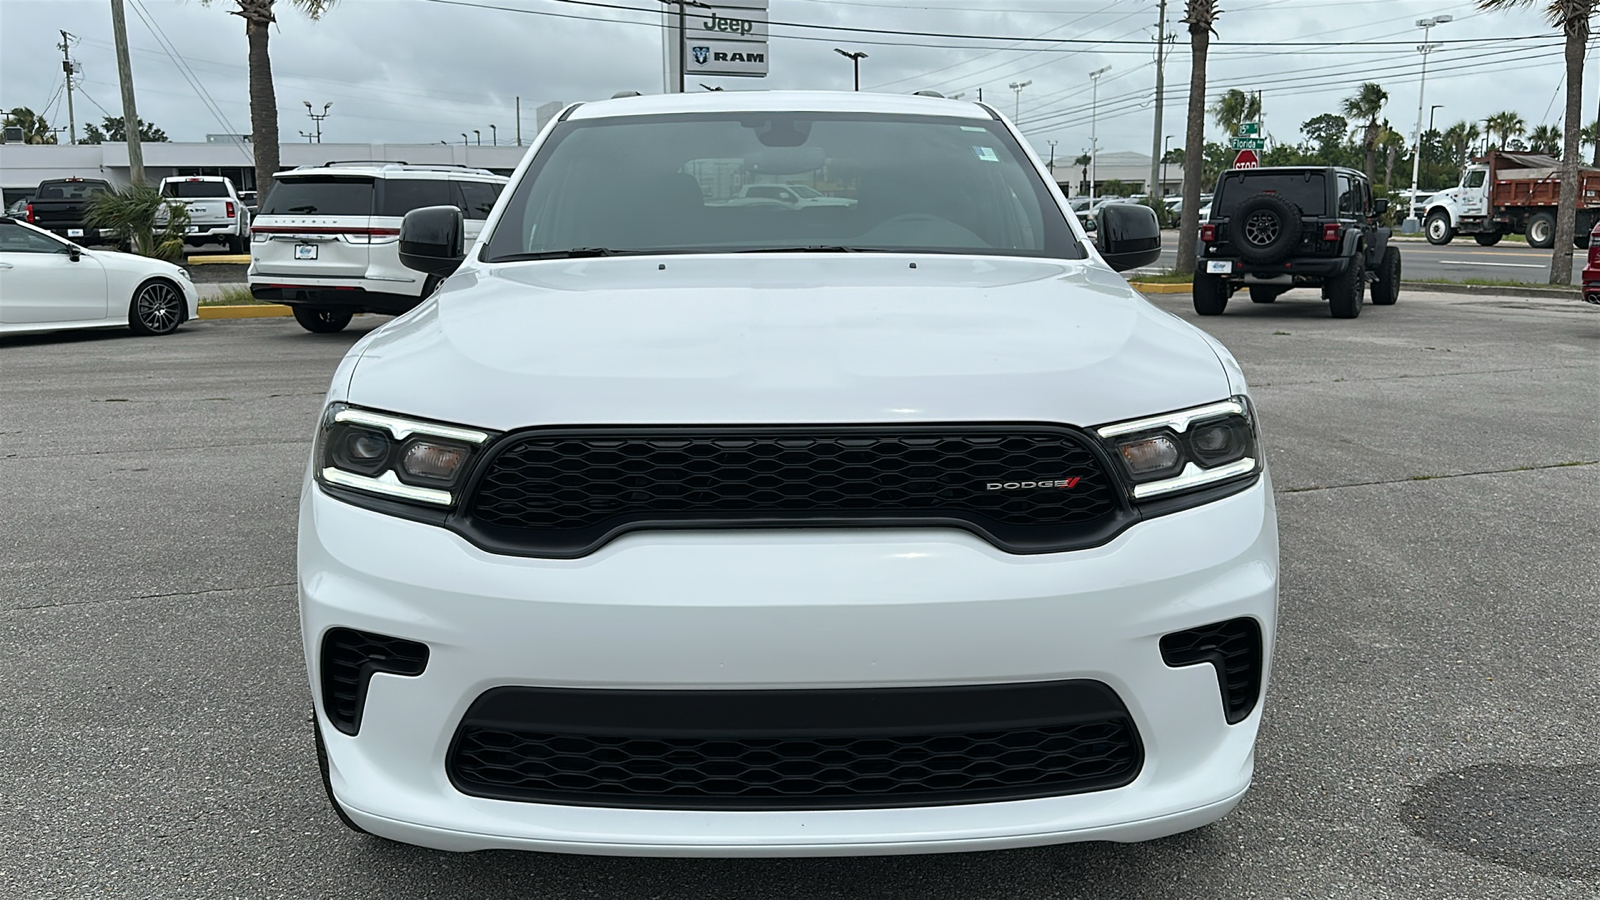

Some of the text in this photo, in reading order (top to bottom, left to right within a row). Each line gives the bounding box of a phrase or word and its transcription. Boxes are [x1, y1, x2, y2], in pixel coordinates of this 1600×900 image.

[703, 13, 753, 36] Jeep
[714, 52, 764, 63] RAM
[1233, 138, 1256, 148] Florida
[986, 479, 1069, 490] DODGE
